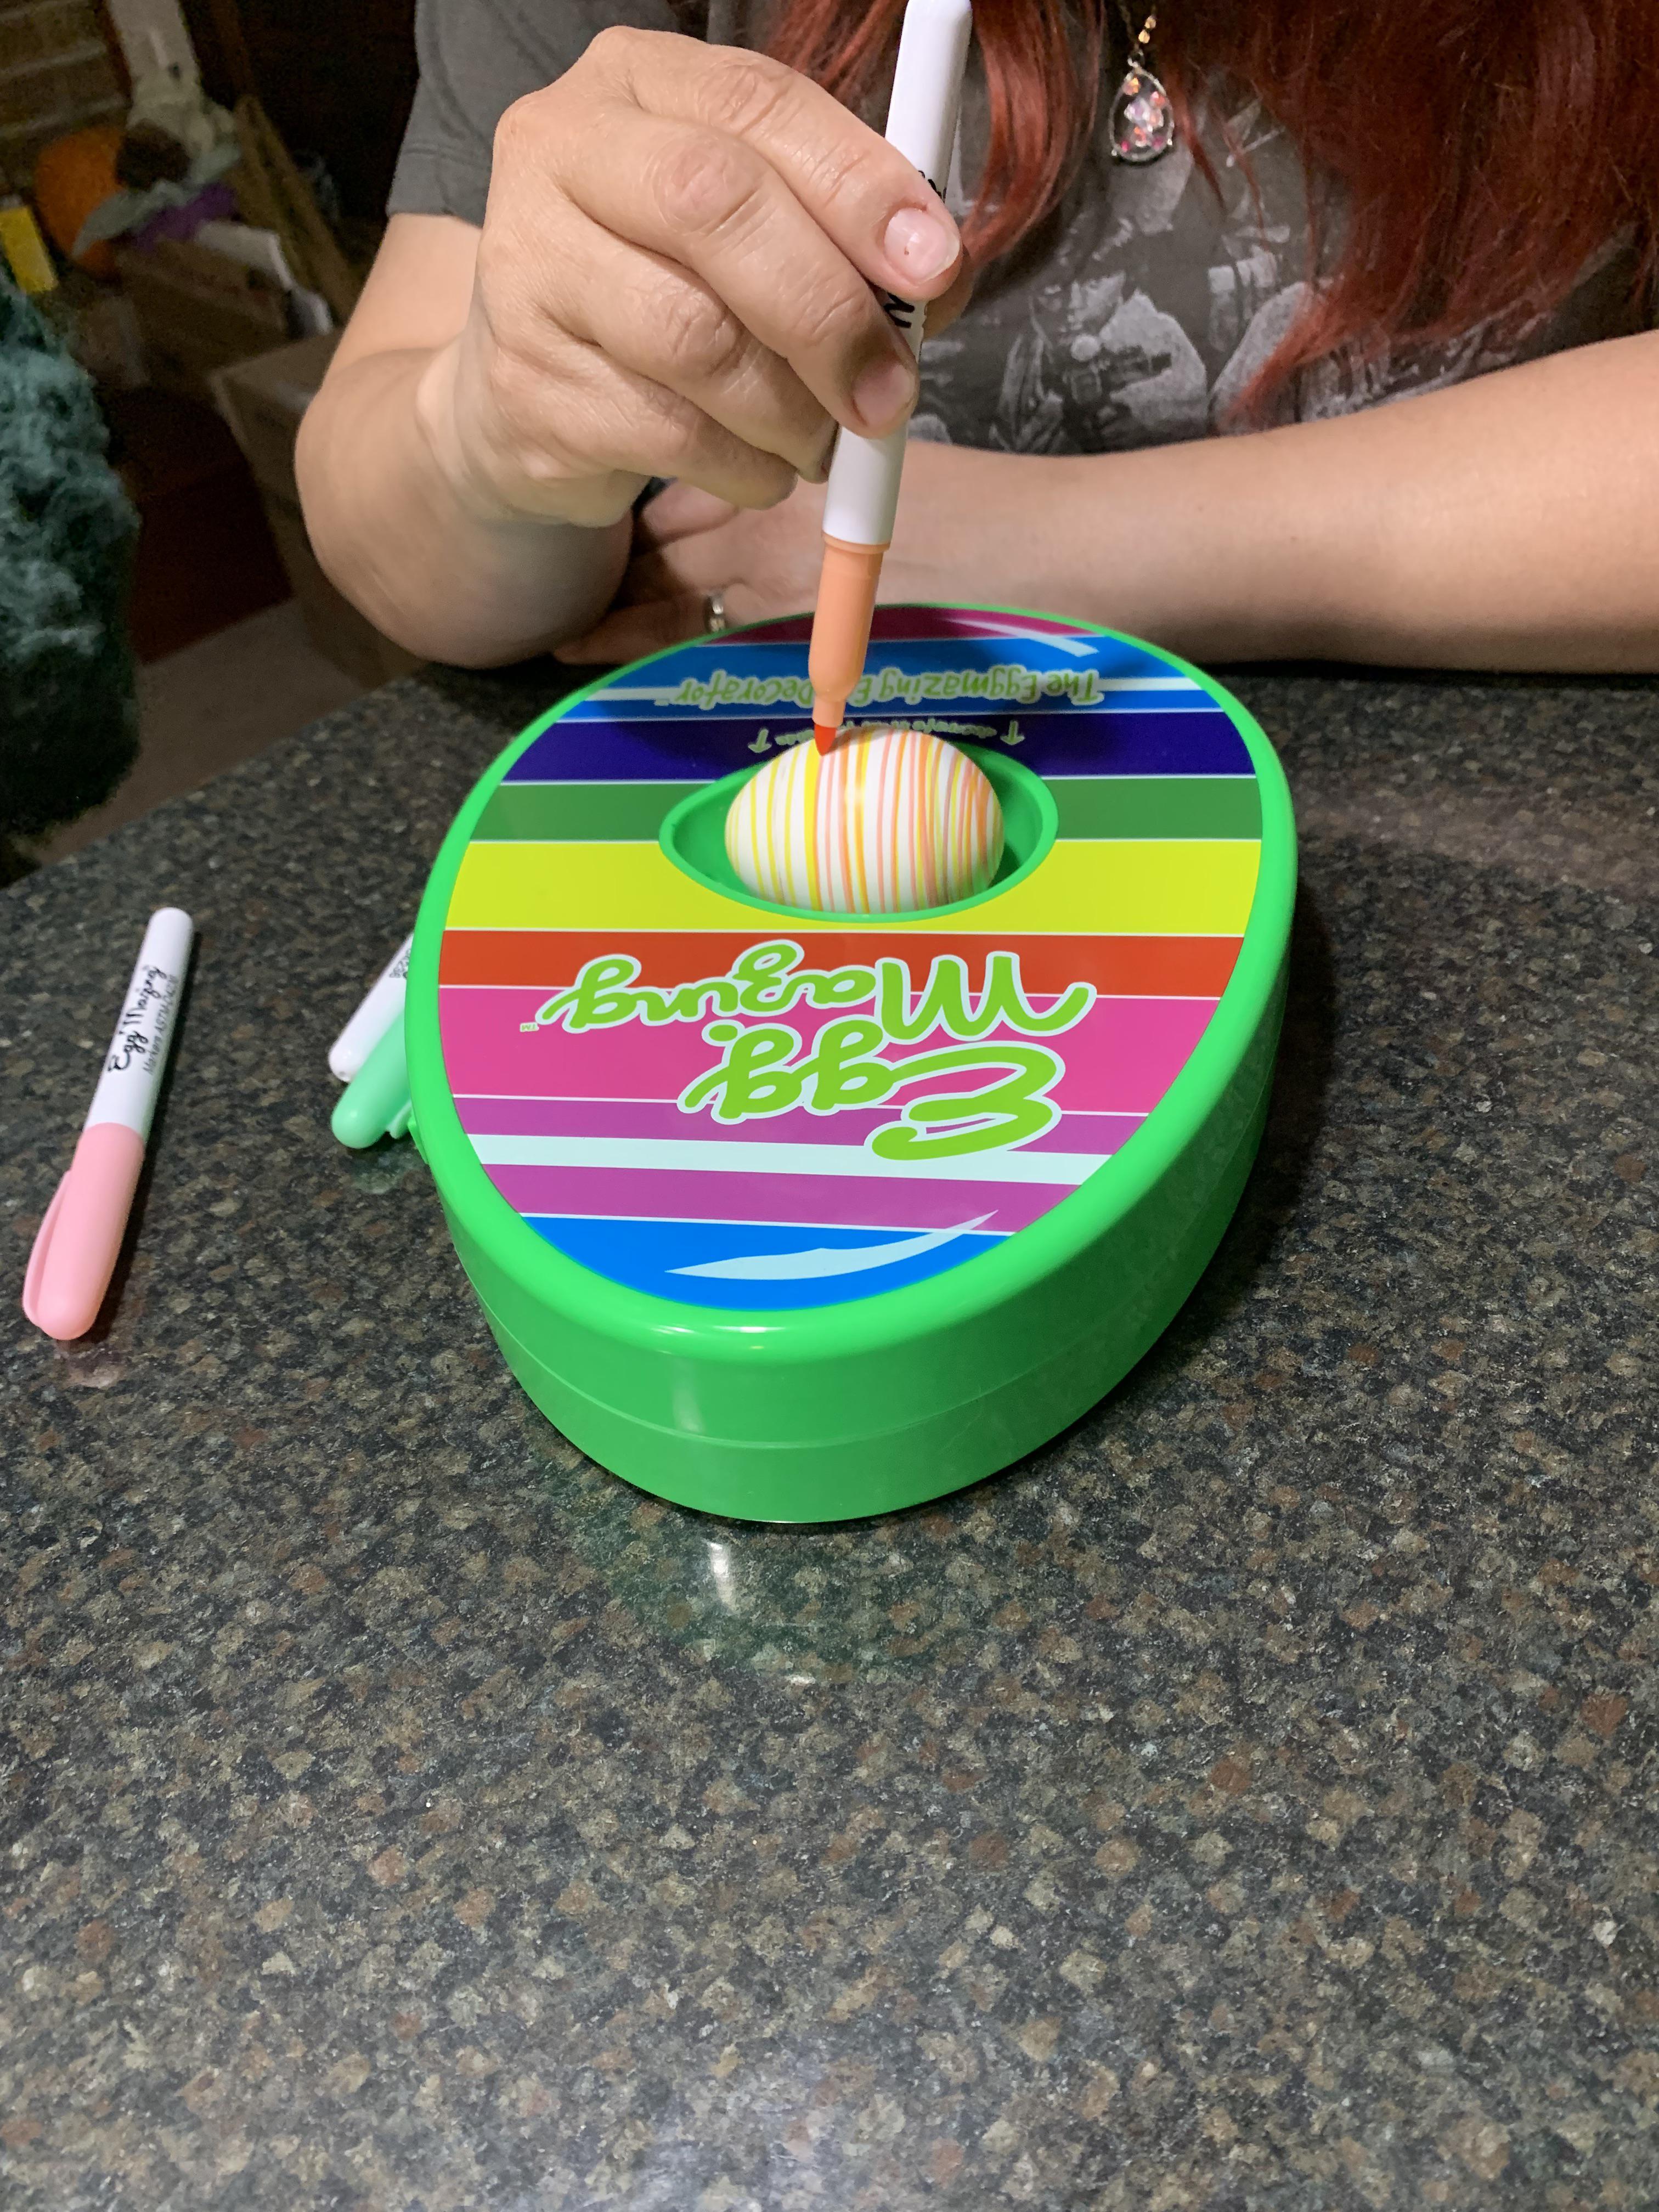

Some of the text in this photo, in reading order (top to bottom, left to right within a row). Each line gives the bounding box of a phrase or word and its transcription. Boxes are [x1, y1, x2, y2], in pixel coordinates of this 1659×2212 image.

[675, 670, 813, 708] Decorator
[879, 667, 1039, 704] Eggmazing
[1046, 669, 1097, 704] The
[541, 941, 1096, 1041] Mazing
[108, 1030, 148, 1071] Egg
[685, 1017, 1058, 1161] Egg
